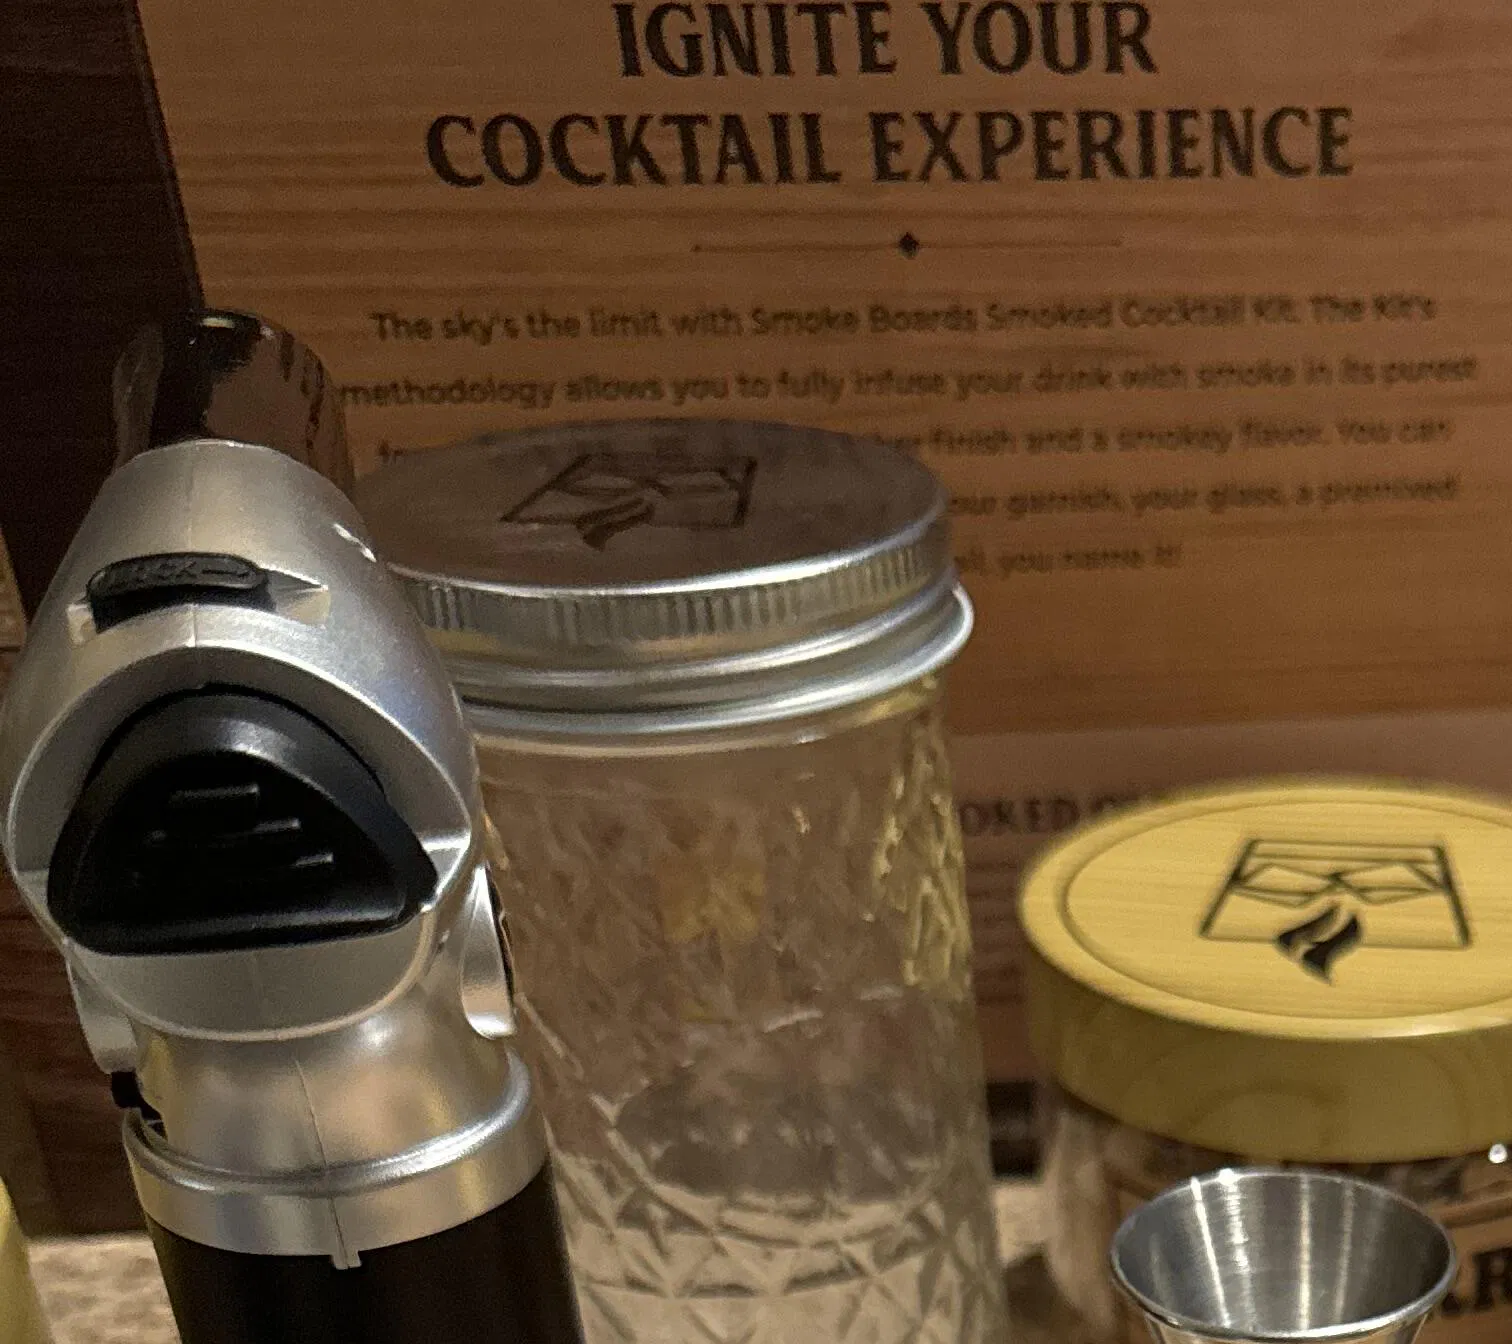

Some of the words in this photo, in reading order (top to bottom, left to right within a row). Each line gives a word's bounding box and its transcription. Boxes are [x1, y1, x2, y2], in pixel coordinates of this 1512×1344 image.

[613, 1, 898, 78] IGNITE
[923, 1, 1159, 75] YOUR
[425, 111, 842, 187] COCKTAIL
[868, 107, 1354, 183] EXPERIENCE
[370, 310, 432, 342] The
[442, 307, 520, 346] sky's
[527, 307, 581, 339] the
[590, 306, 660, 337] limit
[671, 306, 743, 336] with
[752, 304, 857, 335] Smoke
[869, 303, 977, 333] Boards
[984, 301, 1111, 330] Smoked
[1118, 294, 1246, 328] Cocktail
[1308, 294, 1365, 322] The
[340, 376, 556, 410] methodology
[564, 374, 663, 403] allows
[672, 377, 729, 406] you
[735, 369, 771, 398] to
[778, 366, 844, 405] fully
[853, 367, 946, 396] infuse
[955, 371, 1024, 402] your
[1032, 363, 1115, 393] drink
[1119, 363, 1187, 391] with
[1195, 360, 1297, 389] smoke
[1303, 357, 1334, 386] in
[1339, 354, 1377, 385] its
[1022, 426, 1084, 454] and
[1334, 415, 1394, 445] You
